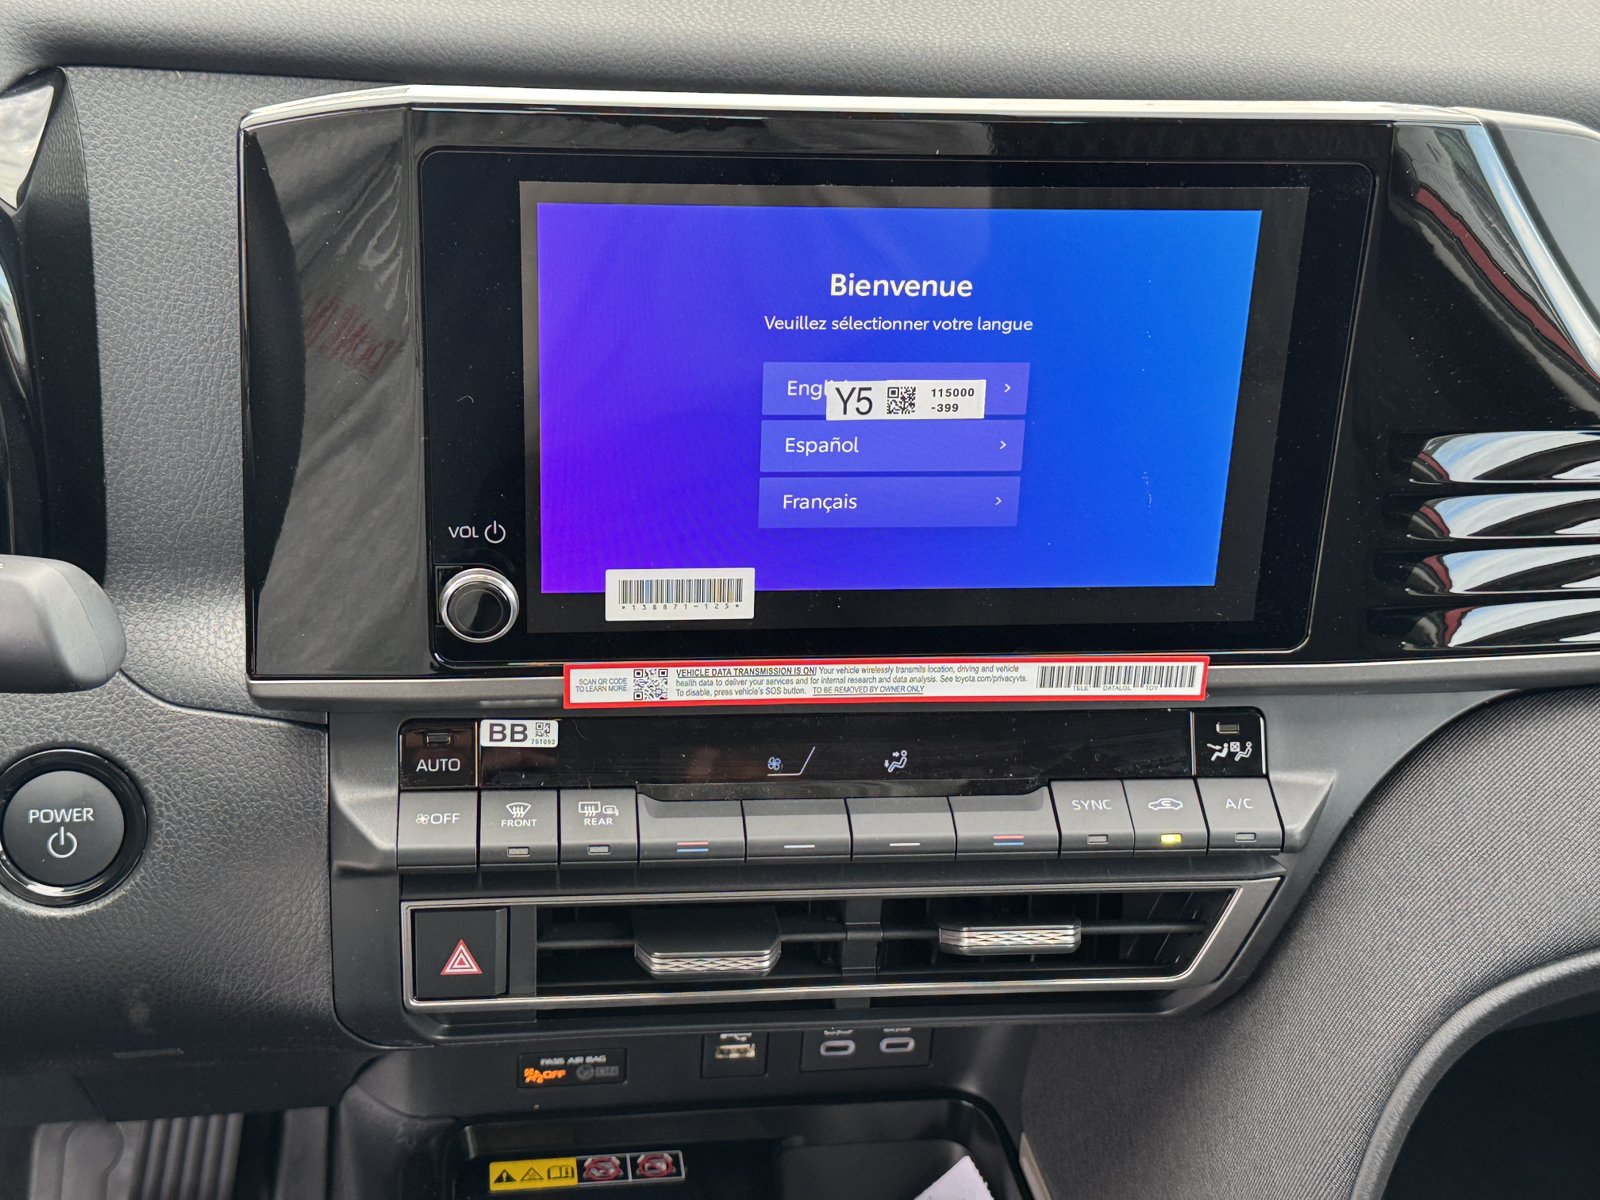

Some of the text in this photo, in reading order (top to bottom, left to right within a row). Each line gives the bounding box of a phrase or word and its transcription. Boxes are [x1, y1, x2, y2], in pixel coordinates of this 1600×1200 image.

[830, 273, 973, 297] Bienvenue
[764, 316, 1033, 334] Veuillez sélectionner votre langue
[787, 379, 830, 400] Engl
[931, 388, 975, 397] 115000
[835, 387, 873, 415] Y5
[931, 403, 959, 412] -399
[785, 437, 859, 456] Español
[783, 493, 857, 513] Français
[448, 526, 479, 538] VOL
[676, 668, 709, 677] VEHICLE
[712, 668, 732, 676] DATA
[734, 667, 792, 676] TRANSMISSION
[794, 667, 801, 675] IS
[819, 667, 835, 675] Your
[836, 666, 860, 674] vehicle
[862, 666, 894, 675] wirelessly
[896, 665, 926, 673] transmits
[928, 665, 955, 674] location,
[957, 665, 979, 674] driving
[981, 665, 994, 673] and
[996, 665, 1019, 673] vehicle
[676, 679, 697, 687] health
[724, 678, 748, 686] deliver
[749, 679, 764, 687] your
[821, 676, 846, 684] internal
[848, 676, 877, 684] research
[893, 675, 907, 683] data
[909, 675, 938, 684] analysis.
[940, 675, 953, 683] See
[686, 688, 712, 697] disable,
[714, 689, 733, 697] press
[765, 687, 782, 695] SOS
[813, 686, 822, 694] TO
[489, 723, 528, 743] BB
[416, 758, 461, 772] AUTO
[1072, 800, 1113, 811] SYNC
[1226, 799, 1253, 809] A/C
[28, 807, 95, 823] POWER
[430, 813, 461, 825] OFF
[501, 818, 537, 827] FRONT
[584, 817, 613, 826] REAR
